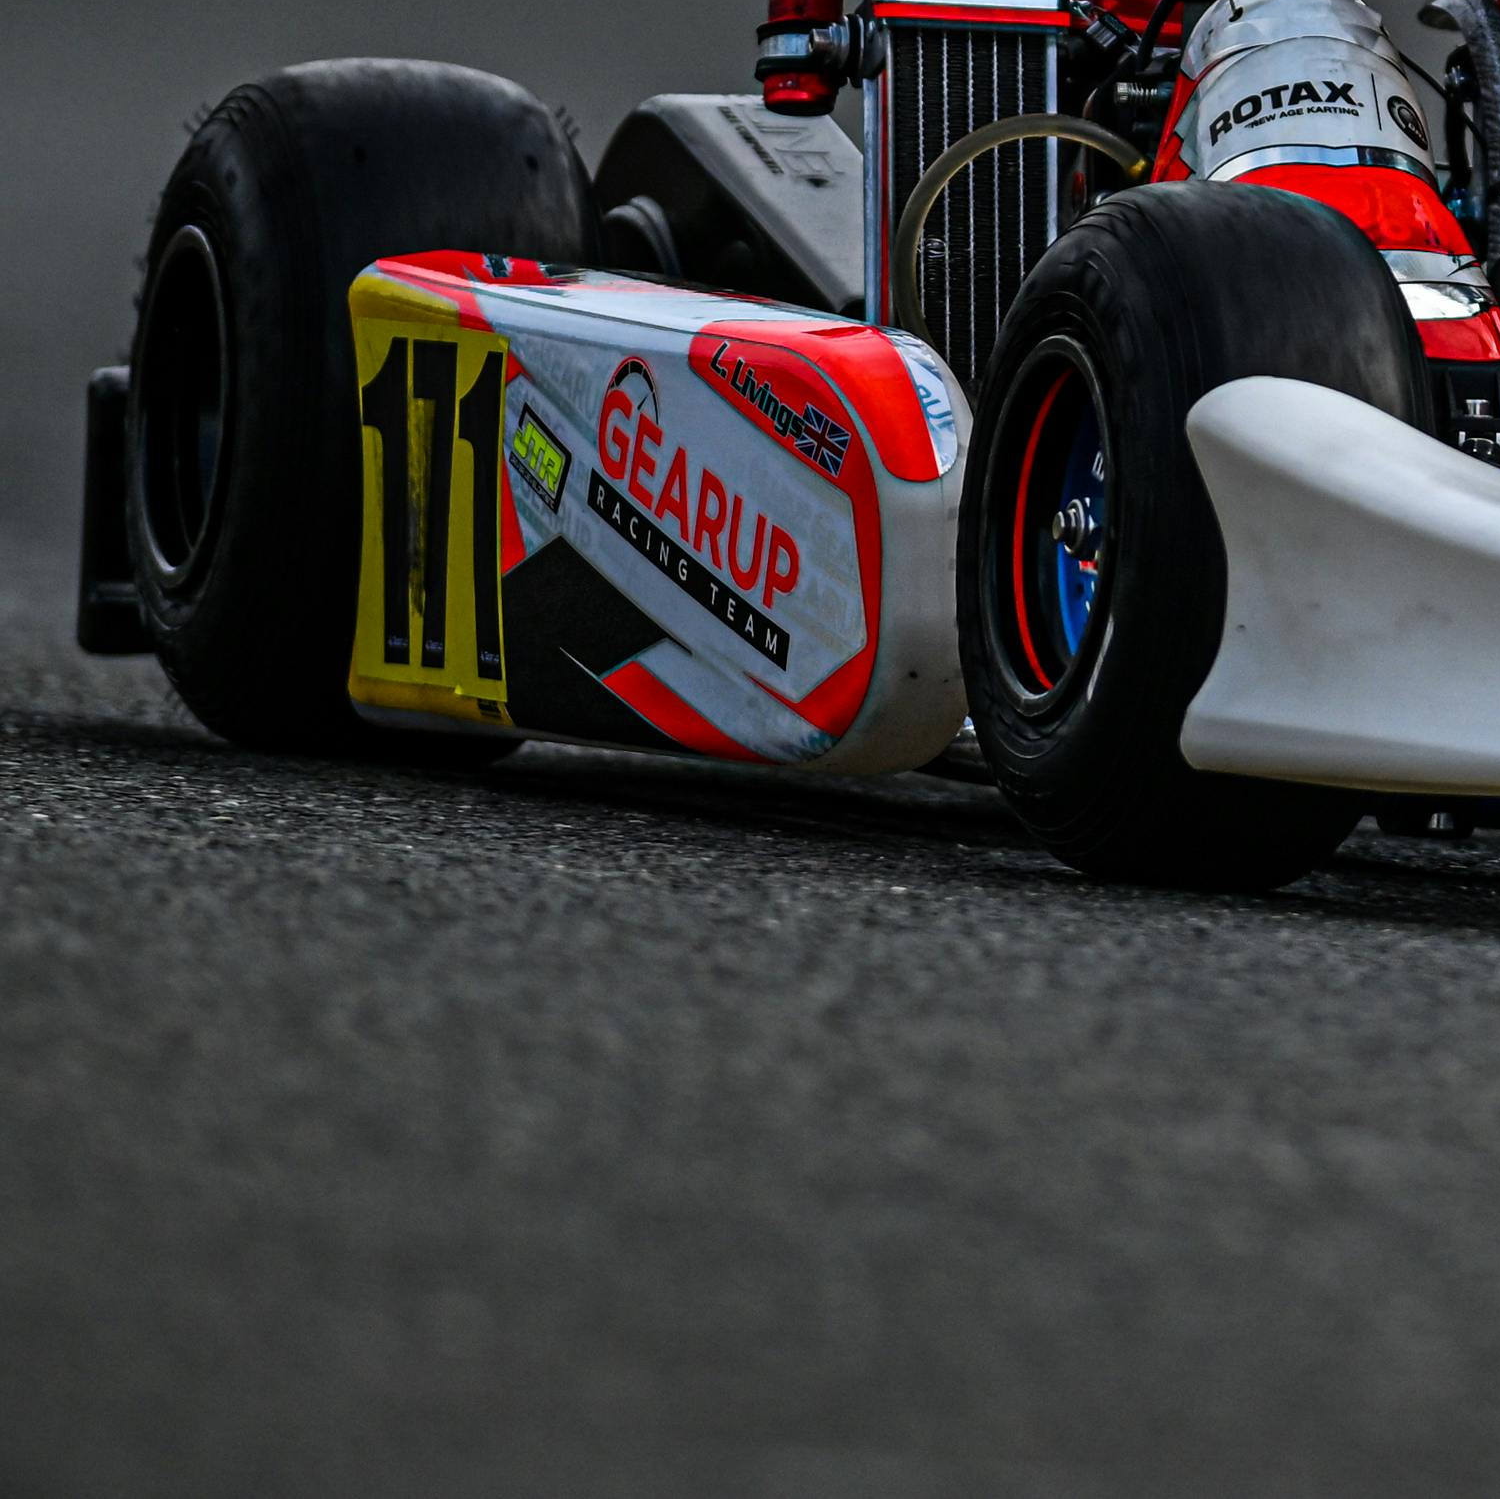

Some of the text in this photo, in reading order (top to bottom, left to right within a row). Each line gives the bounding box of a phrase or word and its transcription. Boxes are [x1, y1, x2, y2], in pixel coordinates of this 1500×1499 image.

[1208, 80, 1358, 147] ROTAX
[1249, 105, 1360, 129] NEW AGE KARTING
[709, 340, 807, 440] L. Livings
[512, 419, 564, 493] JTR
[598, 387, 801, 611] GEARUP
[361, 336, 505, 682] 171
[595, 484, 688, 582] RACING
[709, 582, 779, 655] TEAM
